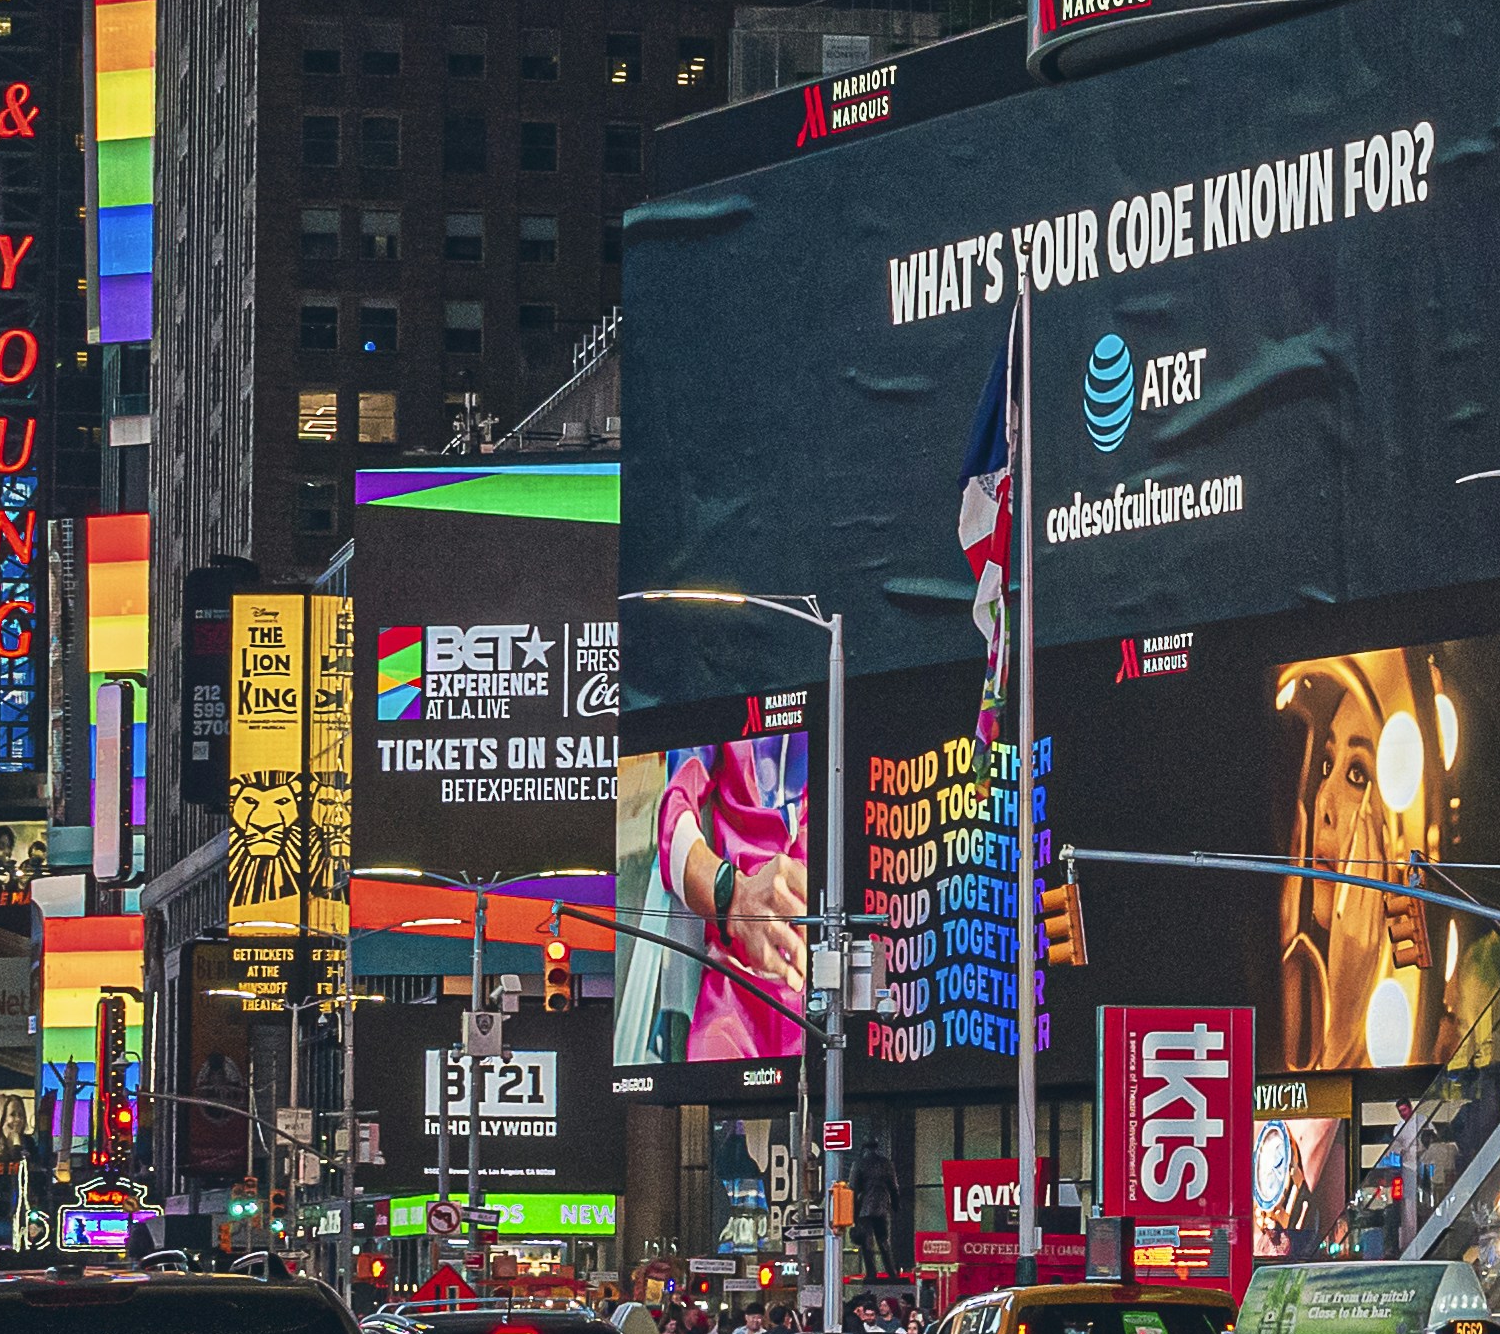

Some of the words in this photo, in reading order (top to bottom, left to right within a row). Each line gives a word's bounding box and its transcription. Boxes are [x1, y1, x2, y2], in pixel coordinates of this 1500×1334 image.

[833, 65, 897, 101] MARRIOTT
[833, 95, 888, 129] MARQUIS
[890, 235, 1003, 325] WHAT'S
[1011, 207, 1098, 295] YOUR
[1108, 183, 1193, 274] CODE
[1203, 150, 1333, 251] KNOWN
[1344, 121, 1435, 217] FOR?
[1141, 348, 1206, 410] AT&T
[1046, 472, 1243, 544] codesofculture.com
[248, 627, 283, 644] THE
[1143, 633, 1193, 652] MARRIOTT
[1143, 653, 1188, 673] MARQUIS
[194, 685, 221, 701] 212
[426, 673, 548, 697] EXPERIENCE
[765, 691, 807, 708] MARRIOTT
[426, 700, 443, 720] AT
[477, 699, 510, 719] LIVE
[765, 711, 802, 729] MARQUIS
[378, 738, 498, 772] TICKETS
[508, 737, 546, 769] ON
[870, 751, 938, 796] PROUD
[865, 798, 931, 840] PROUD
[870, 839, 937, 885] PROUD
[865, 888, 931, 929] PROUD
[233, 948, 252, 962] GET
[254, 948, 294, 962] TICKETS
[247, 966, 259, 978] AT
[260, 966, 280, 979] THE
[868, 1019, 937, 1064] PROUD
[1141, 1023, 1230, 1203] tkts
[1127, 1121, 1137, 1177] Development
[1129, 1179, 1137, 1201] Fund
[1312, 1293, 1333, 1304] Far
[1335, 1292, 1359, 1304] from
[1361, 1291, 1379, 1302] the
[1380, 1289, 1415, 1305] pitch?
[1308, 1307, 1336, 1319] Close
[1338, 1307, 1350, 1319] to
[1352, 1306, 1371, 1319] the
